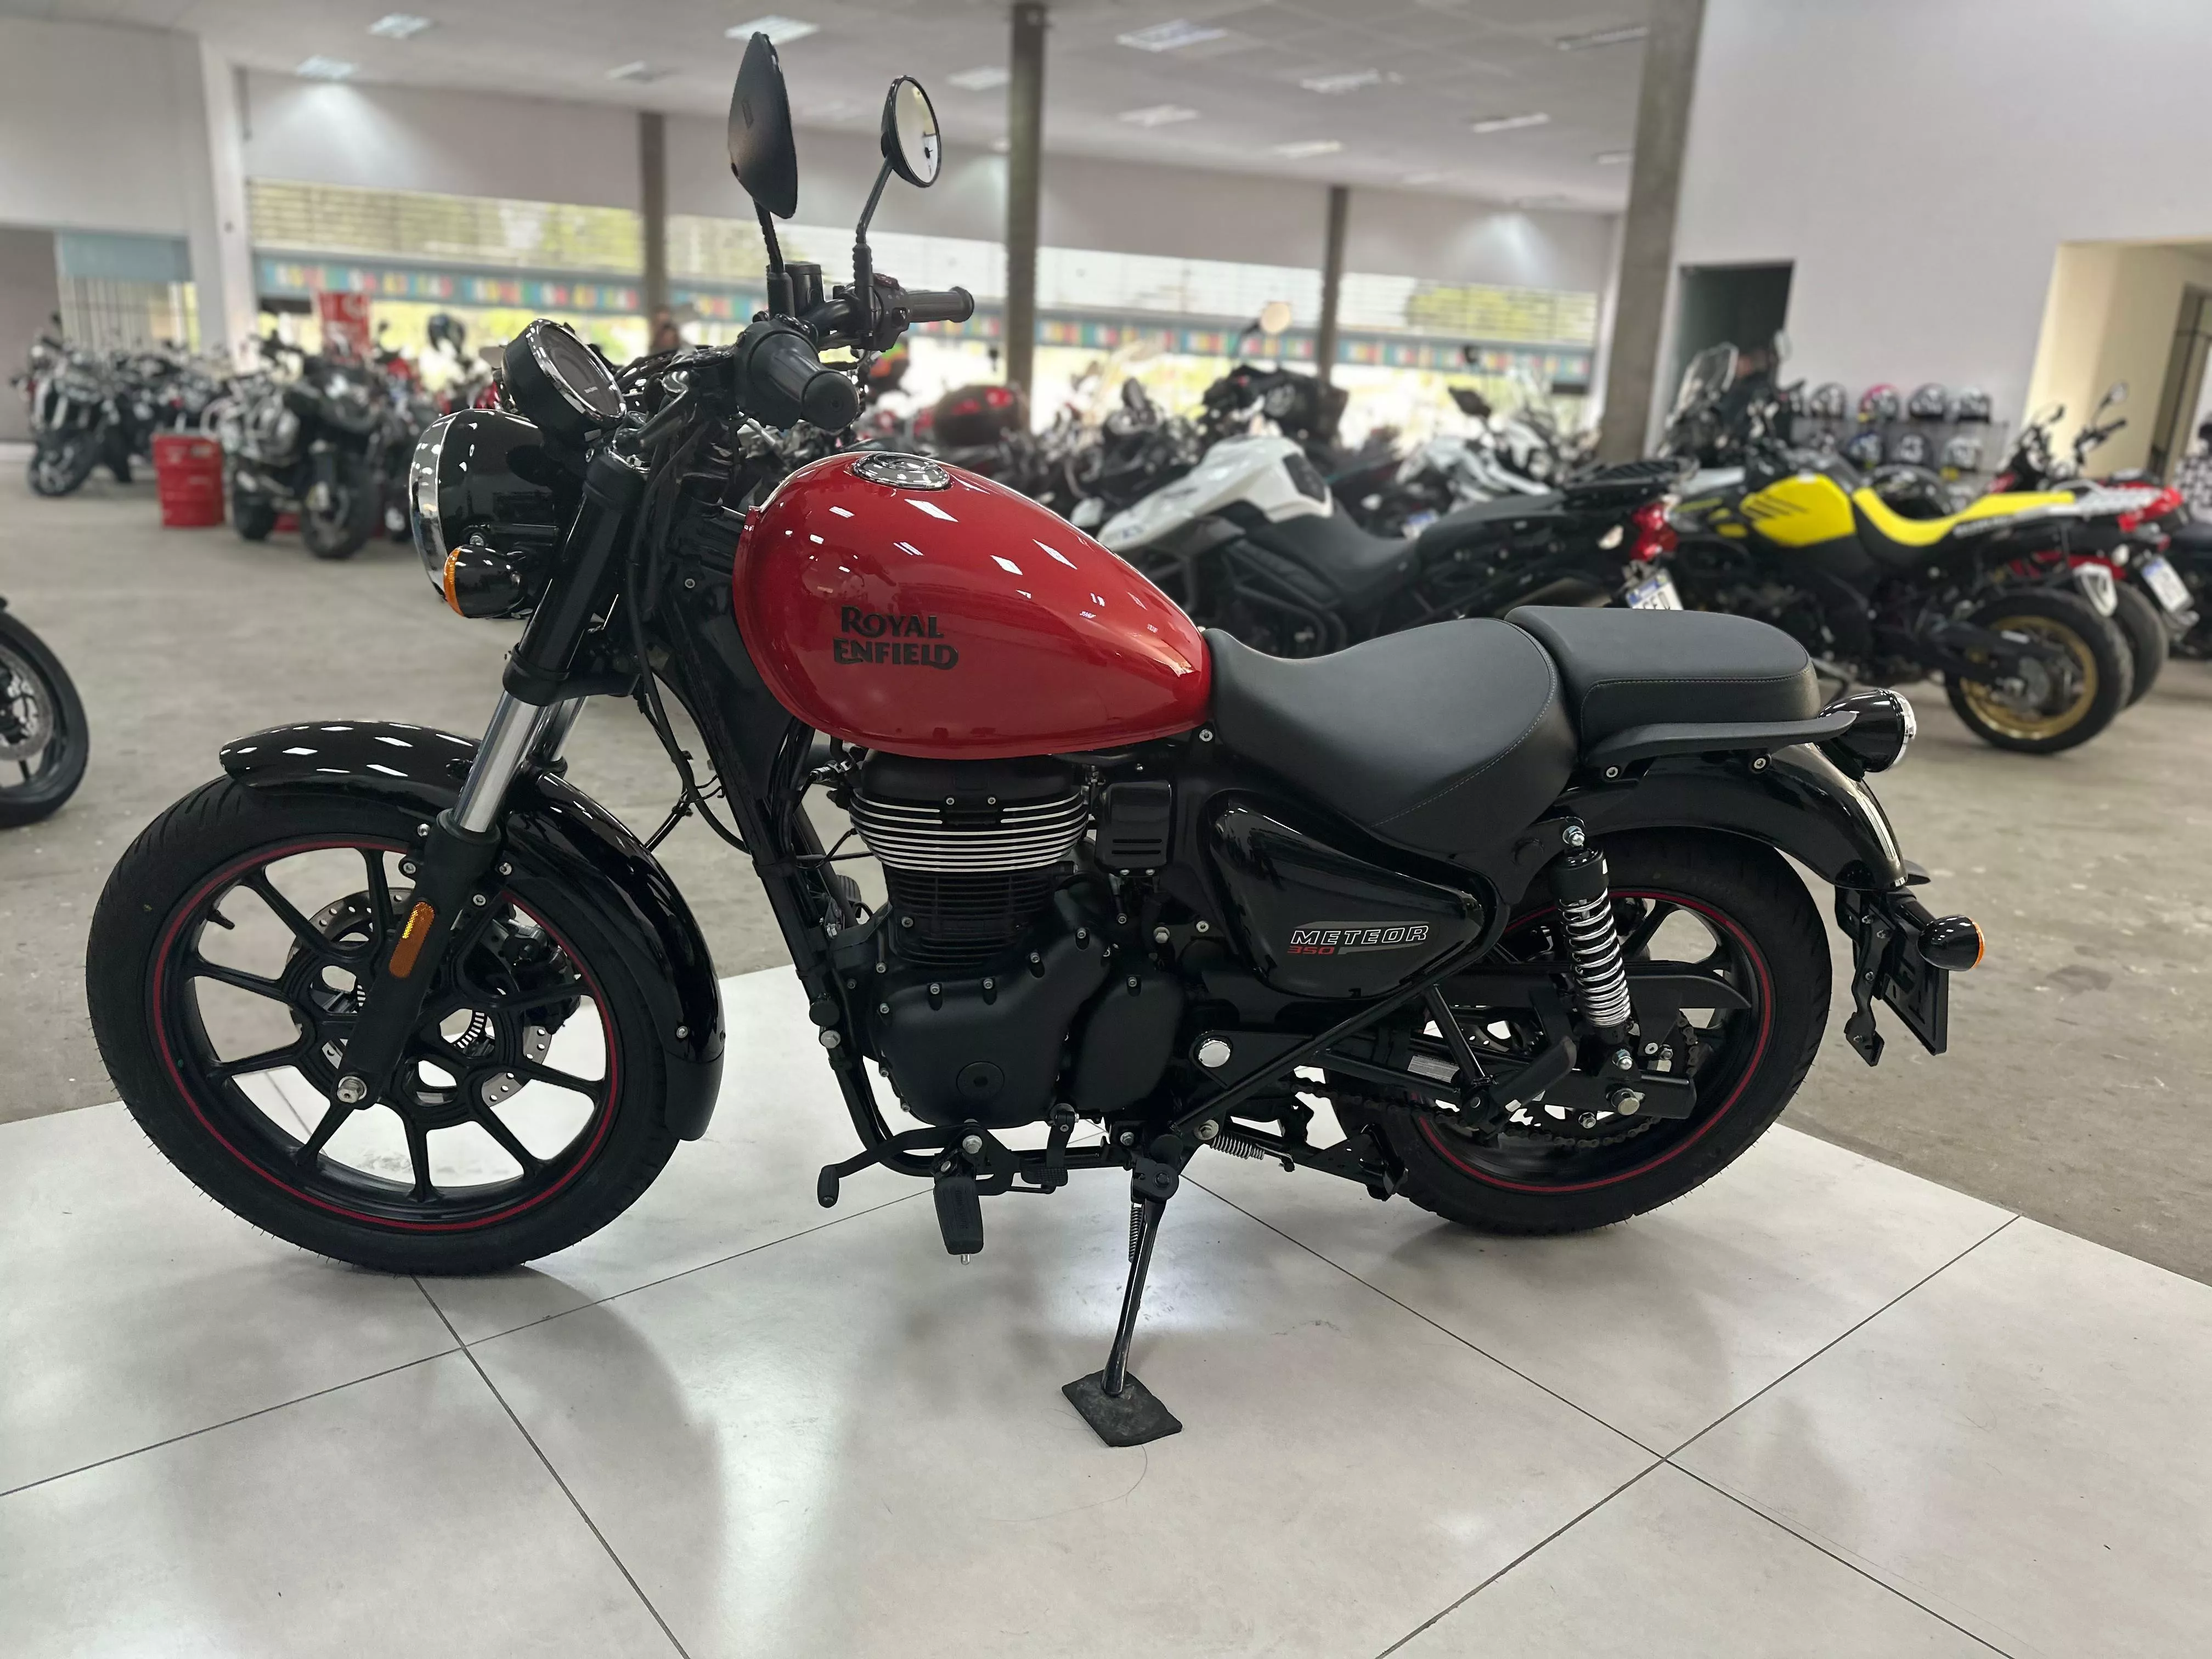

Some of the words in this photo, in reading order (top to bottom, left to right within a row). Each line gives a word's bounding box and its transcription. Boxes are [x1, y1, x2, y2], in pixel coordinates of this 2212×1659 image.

[840, 606, 945, 639] ROYAL
[833, 637, 959, 670] ENFIELD
[1290, 925, 1429, 946] METEOR
[1287, 945, 1336, 955] 350
